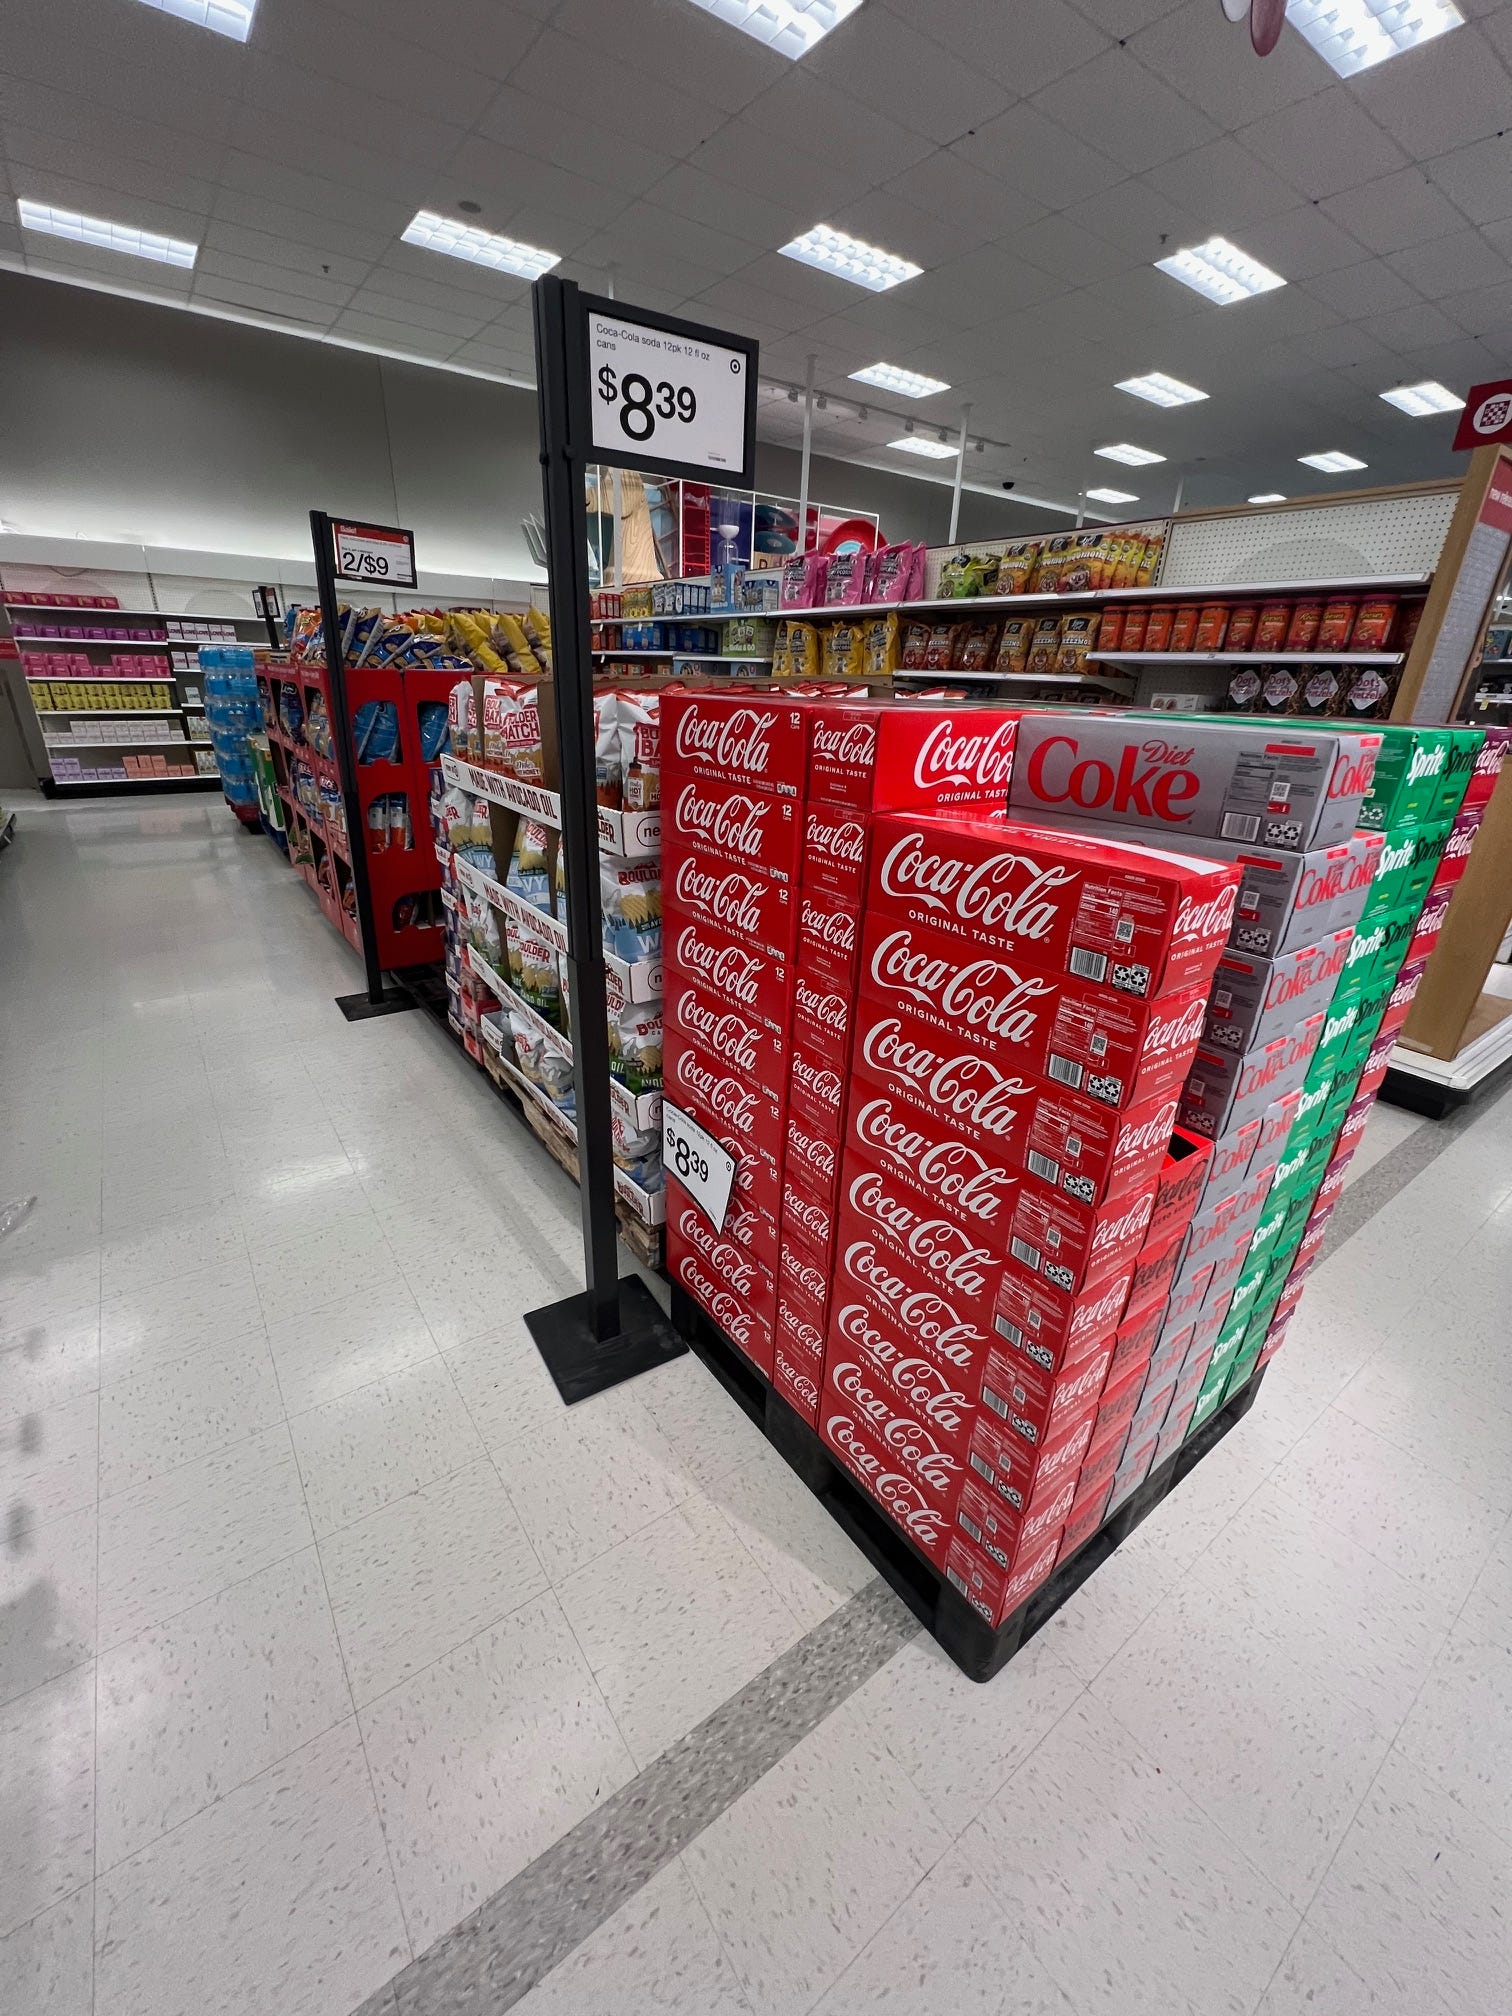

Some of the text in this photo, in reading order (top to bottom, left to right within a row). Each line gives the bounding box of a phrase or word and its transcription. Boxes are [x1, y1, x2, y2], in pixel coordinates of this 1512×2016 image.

[596, 323, 640, 343] Coca-Cola
[641, 336, 661, 349] soda
[663, 341, 682, 354] 12pk
[684, 346, 693, 357] 12
[701, 351, 710, 361] oz
[596, 339, 616, 351] cans
[342, 551, 389, 576] 2/$9
[675, 704, 779, 772] Coca-Cola
[790, 712, 800, 725] 12
[693, 765, 751, 785] ORIGINAL TASTE
[814, 764, 867, 779] ORIGINAL TASTE
[913, 719, 1018, 789] Coca-Co
[1142, 739, 1196, 767] Diet
[485, 775, 507, 800] WITH
[505, 781, 541, 813] AVOCADO
[540, 793, 558, 820] OIL
[937, 790, 982, 803] ORIGINAL
[1027, 735, 1201, 823] Coke
[643, 827, 661, 838] ne
[675, 783, 773, 856] Coca-Cola
[782, 804, 792, 817] 12
[692, 840, 746, 866] ORIGINAL TASTE
[807, 854, 857, 874] ORIGINAL TASTE
[617, 870, 661, 886] BOULD
[676, 857, 770, 933] Coca-Cola
[778, 888, 789, 901] 12
[880, 832, 1082, 940] Coca-Cola
[1294, 865, 1343, 910] Coke
[483, 880, 503, 908] MADE
[500, 896, 521, 922] WITH
[553, 929, 567, 953] OIL
[723, 925, 745, 941] TASTE
[908, 909, 1015, 952] ORIGINAL TASTE
[677, 925, 767, 1004] Coca-Cola
[775, 966, 785, 979] 12
[830, 948, 849, 961] TASTE
[1171, 938, 1225, 961] ORIGINAL TASTE
[870, 930, 1059, 1043] Coca-Cola
[677, 989, 764, 1071] Coca-Cola
[772, 1038, 782, 1051] 12
[897, 1000, 997, 1051] ORIGINAL TASTE
[863, 1018, 1037, 1136] Coca-Cola
[1141, 1046, 1195, 1075] ORIGINAL TASTE
[677, 1049, 762, 1133] Coca-Cola
[770, 1105, 779, 1117] 12
[888, 1083, 980, 1141] ORIGINAL TASTE
[769, 1167, 778, 1180] 12
[856, 1098, 1019, 1220] Coca-Cola
[1113, 1144, 1166, 1177] ORIGINAL TASTE
[880, 1159, 967, 1222] ORIGINAL TASTE
[679, 1209, 758, 1296] Coca-Cola
[849, 1172, 1003, 1296] Coca-Cola
[871, 1228, 954, 1296] ORIGINAL TASTE
[680, 1256, 757, 1345] Coca-Cola
[844, 1241, 989, 1367] Coca-Cola
[865, 1294, 943, 1365] ORIGINAL TASTE
[838, 1304, 976, 1432] Coca-Cola
[858, 1354, 934, 1428] ORIGINAL TASTE
[832, 1362, 964, 1491] Coca-Cola
[826, 1415, 951, 1546] Coca-Cola
